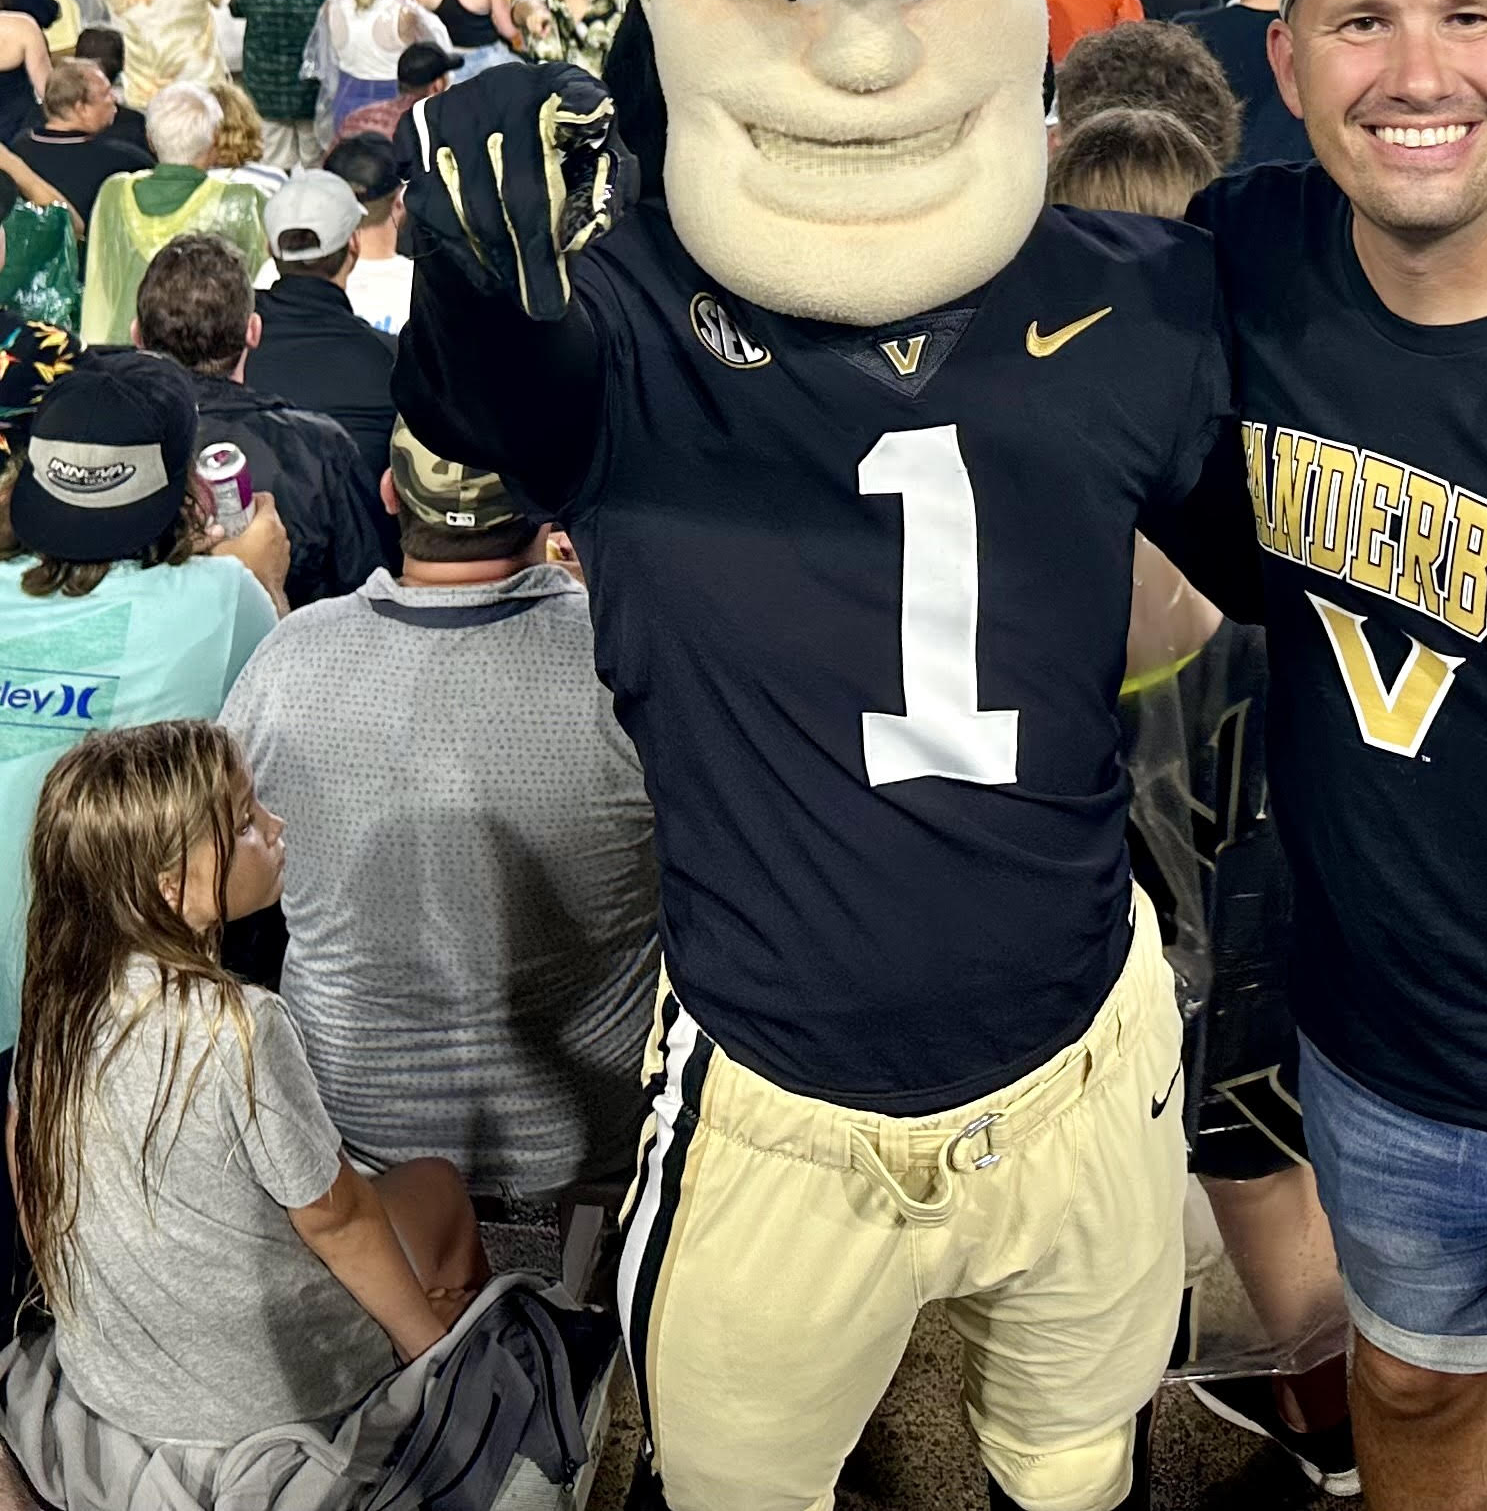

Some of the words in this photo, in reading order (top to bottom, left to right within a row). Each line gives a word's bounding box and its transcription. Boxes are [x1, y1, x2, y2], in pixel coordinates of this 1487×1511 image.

[698, 297, 767, 365] SEC
[879, 334, 927, 377] V
[857, 423, 1019, 788] 1
[0, 680, 56, 714] ley
[1304, 590, 1467, 759] V
